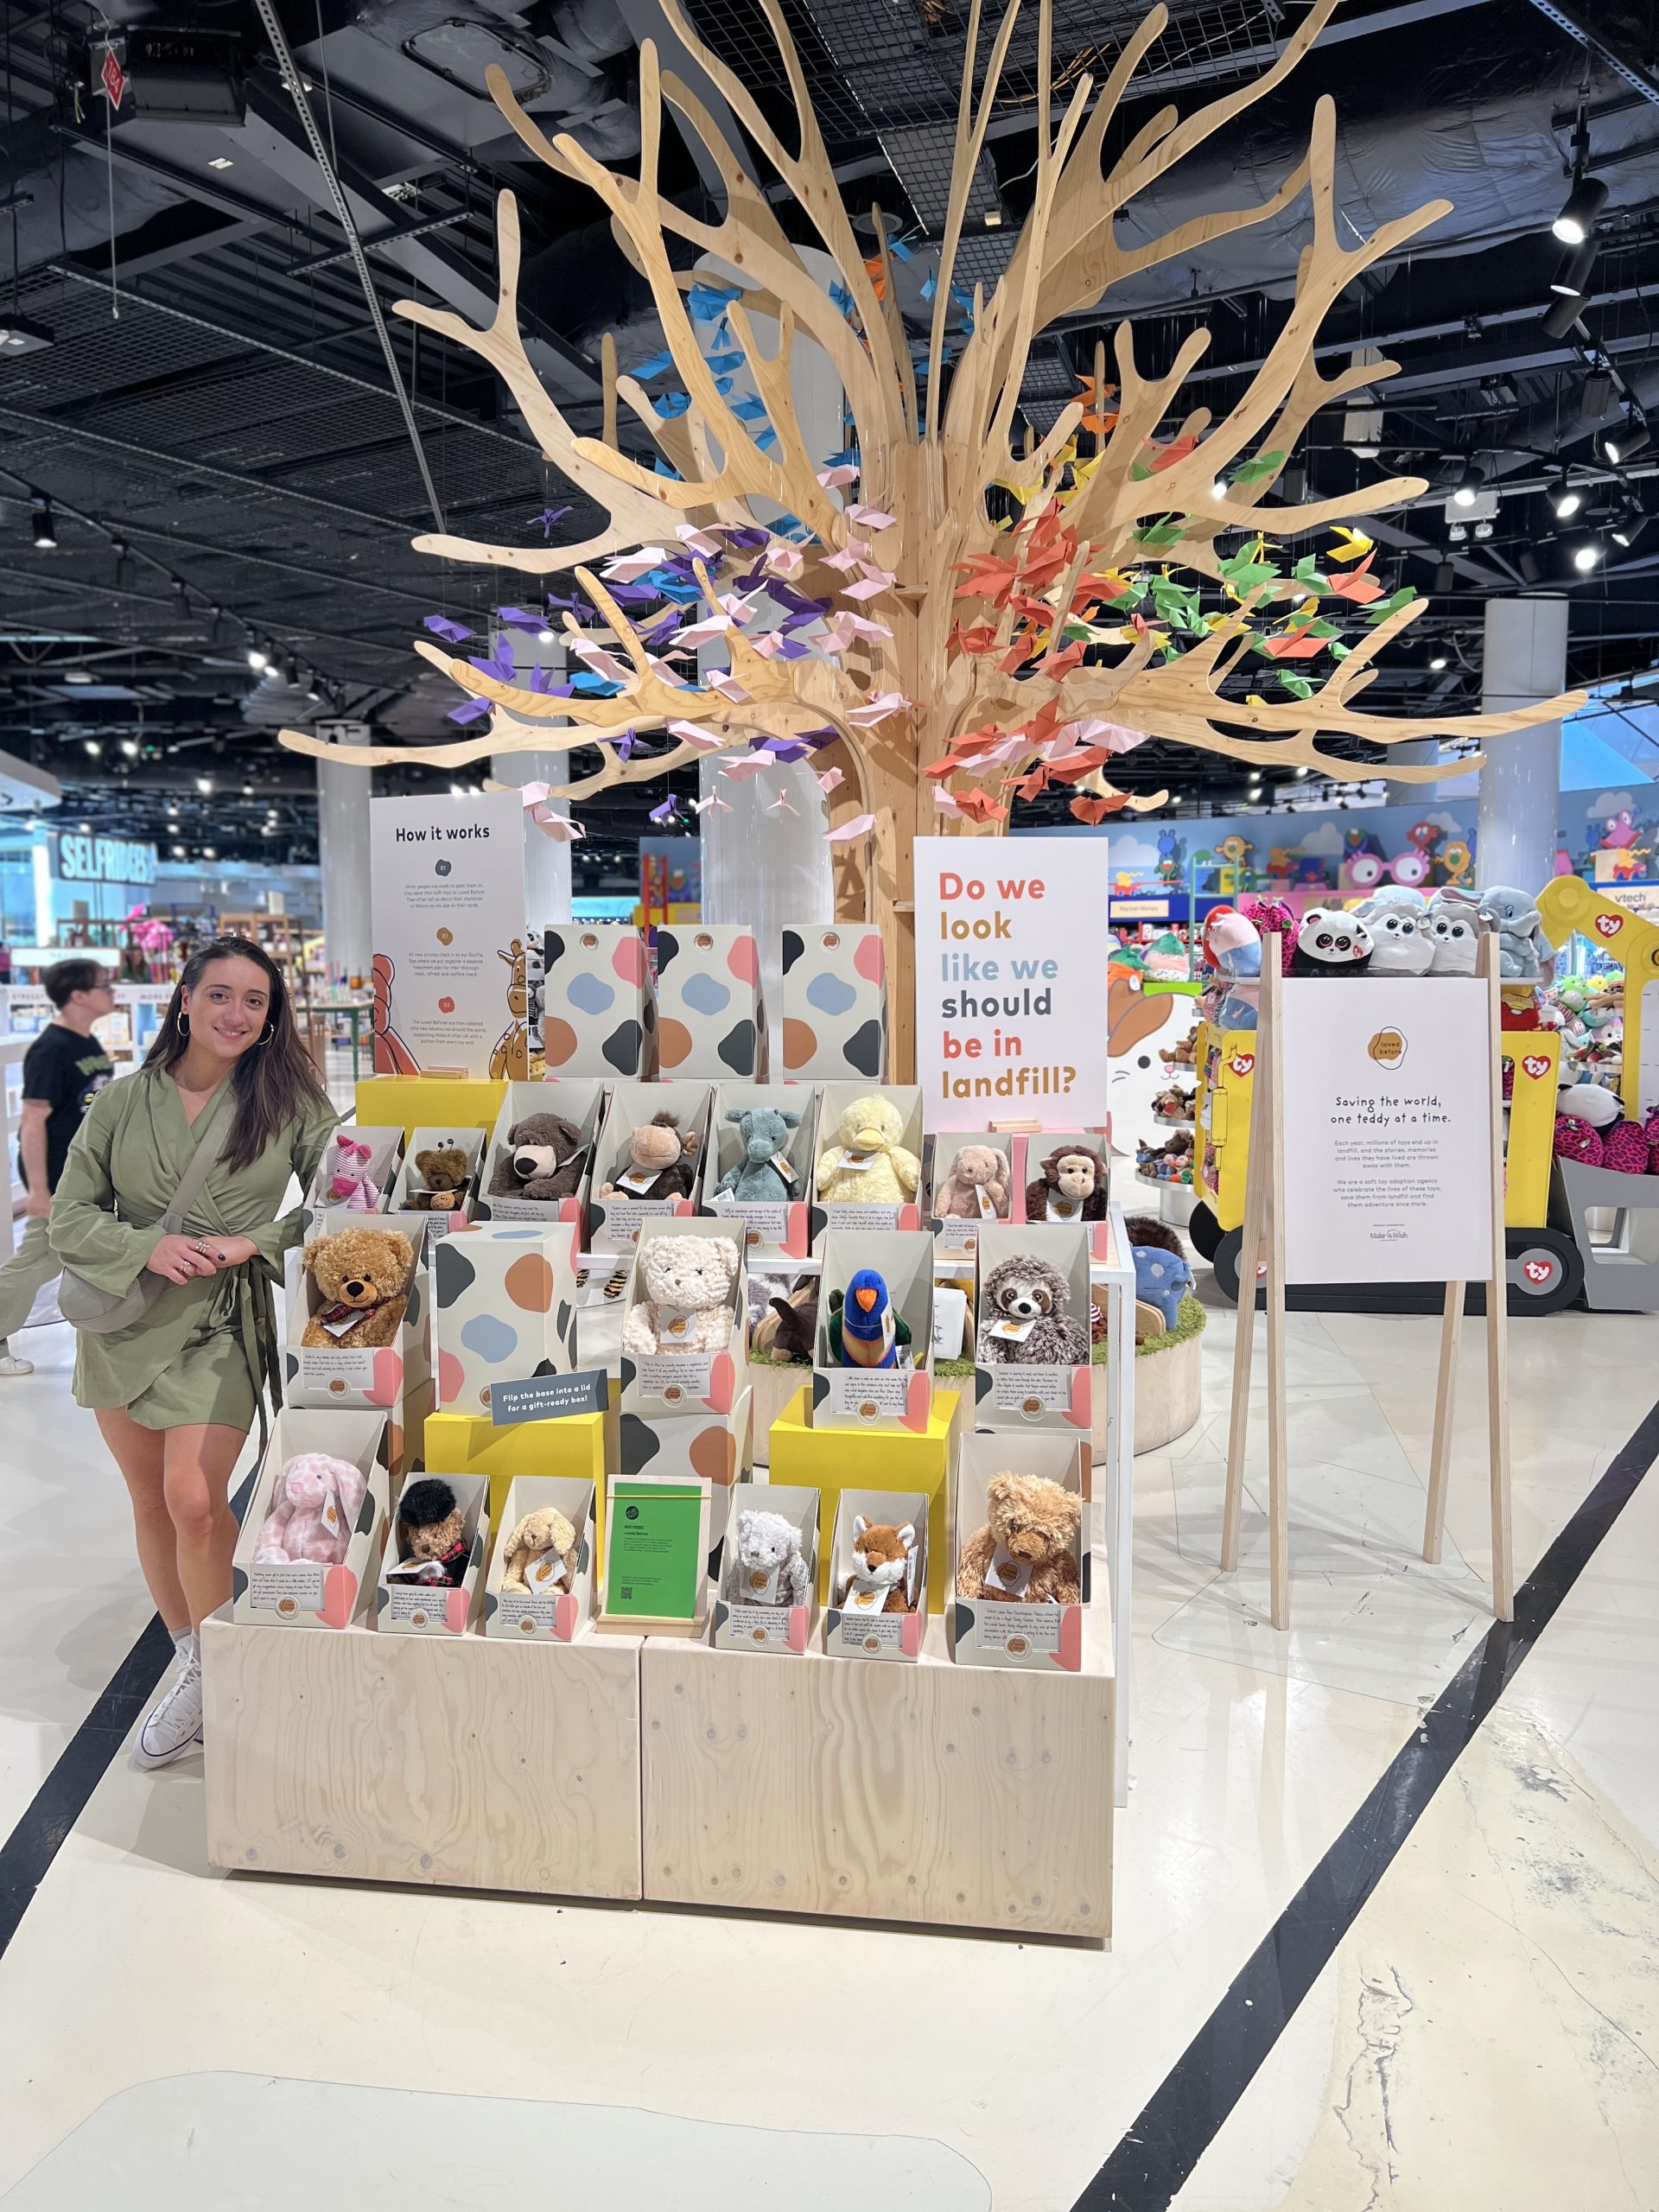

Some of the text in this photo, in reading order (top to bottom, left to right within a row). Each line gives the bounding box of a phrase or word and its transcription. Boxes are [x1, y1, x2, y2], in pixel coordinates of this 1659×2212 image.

[397, 823, 489, 842] How it works
[939, 873, 1045, 899] Do we
[1615, 893, 1646, 902] vtech
[941, 911, 1012, 939] look
[1598, 916, 1620, 934] ty
[942, 953, 1058, 982] like we
[942, 988, 1051, 1018] should
[943, 1029, 1021, 1058] be in
[1233, 1057, 1253, 1073] ty
[1524, 1056, 1548, 1075] ty
[943, 1065, 1077, 1098] landfill?
[1335, 1096, 1441, 1113] Saving the world,
[1357, 1113, 1389, 1127] teddy
[1395, 1113, 1406, 1122] at
[1422, 1113, 1451, 1122] time.
[1526, 1262, 1550, 1280] ty
[529, 1398, 569, 1410] gift-ready
[571, 1395, 588, 1403] box!
